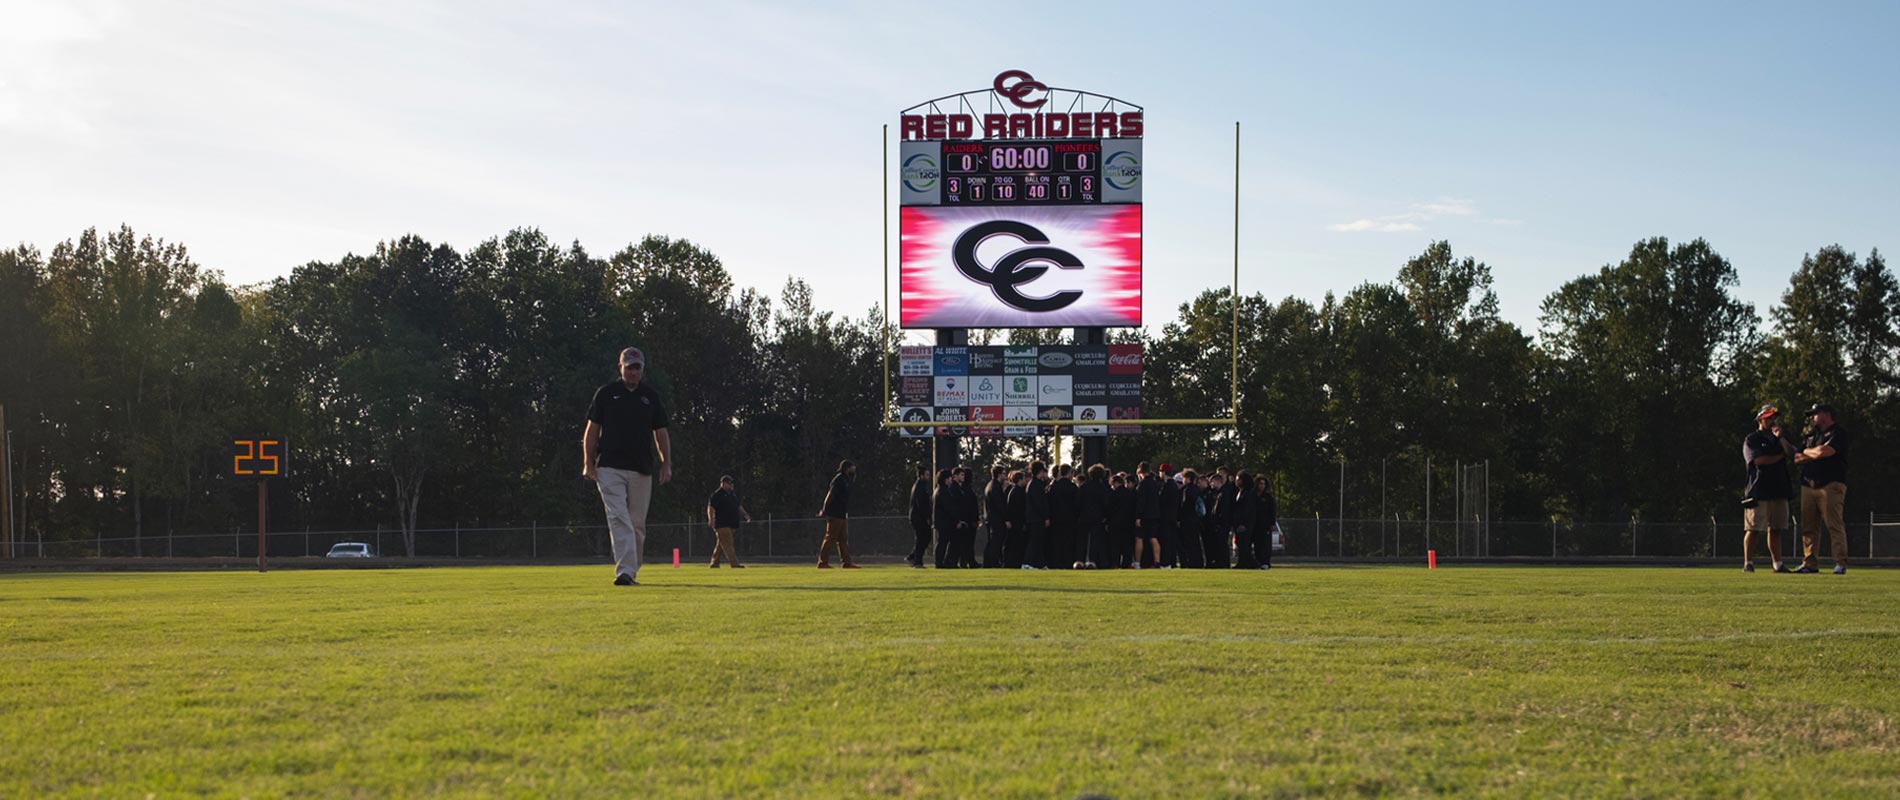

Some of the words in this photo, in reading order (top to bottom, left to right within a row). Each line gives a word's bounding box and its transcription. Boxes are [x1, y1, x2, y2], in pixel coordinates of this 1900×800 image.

[901, 114, 973, 140] RED
[984, 112, 1143, 139] RAIDERS
[944, 144, 983, 153] RAIDERS
[962, 154, 972, 171] 0
[991, 147, 1049, 169] 60:00
[1077, 153, 1087, 170] 0
[950, 180, 957, 192] 3
[1061, 185, 1066, 197] 1
[1084, 178, 1091, 191] 3
[974, 186, 980, 198] 1
[998, 186, 1013, 198] 10
[1029, 185, 1045, 198] 40
[952, 219, 1085, 313] CC
[1004, 366, 1019, 374] GRAIN
[1025, 366, 1037, 374] FEED
[234, 440, 278, 474] 25
